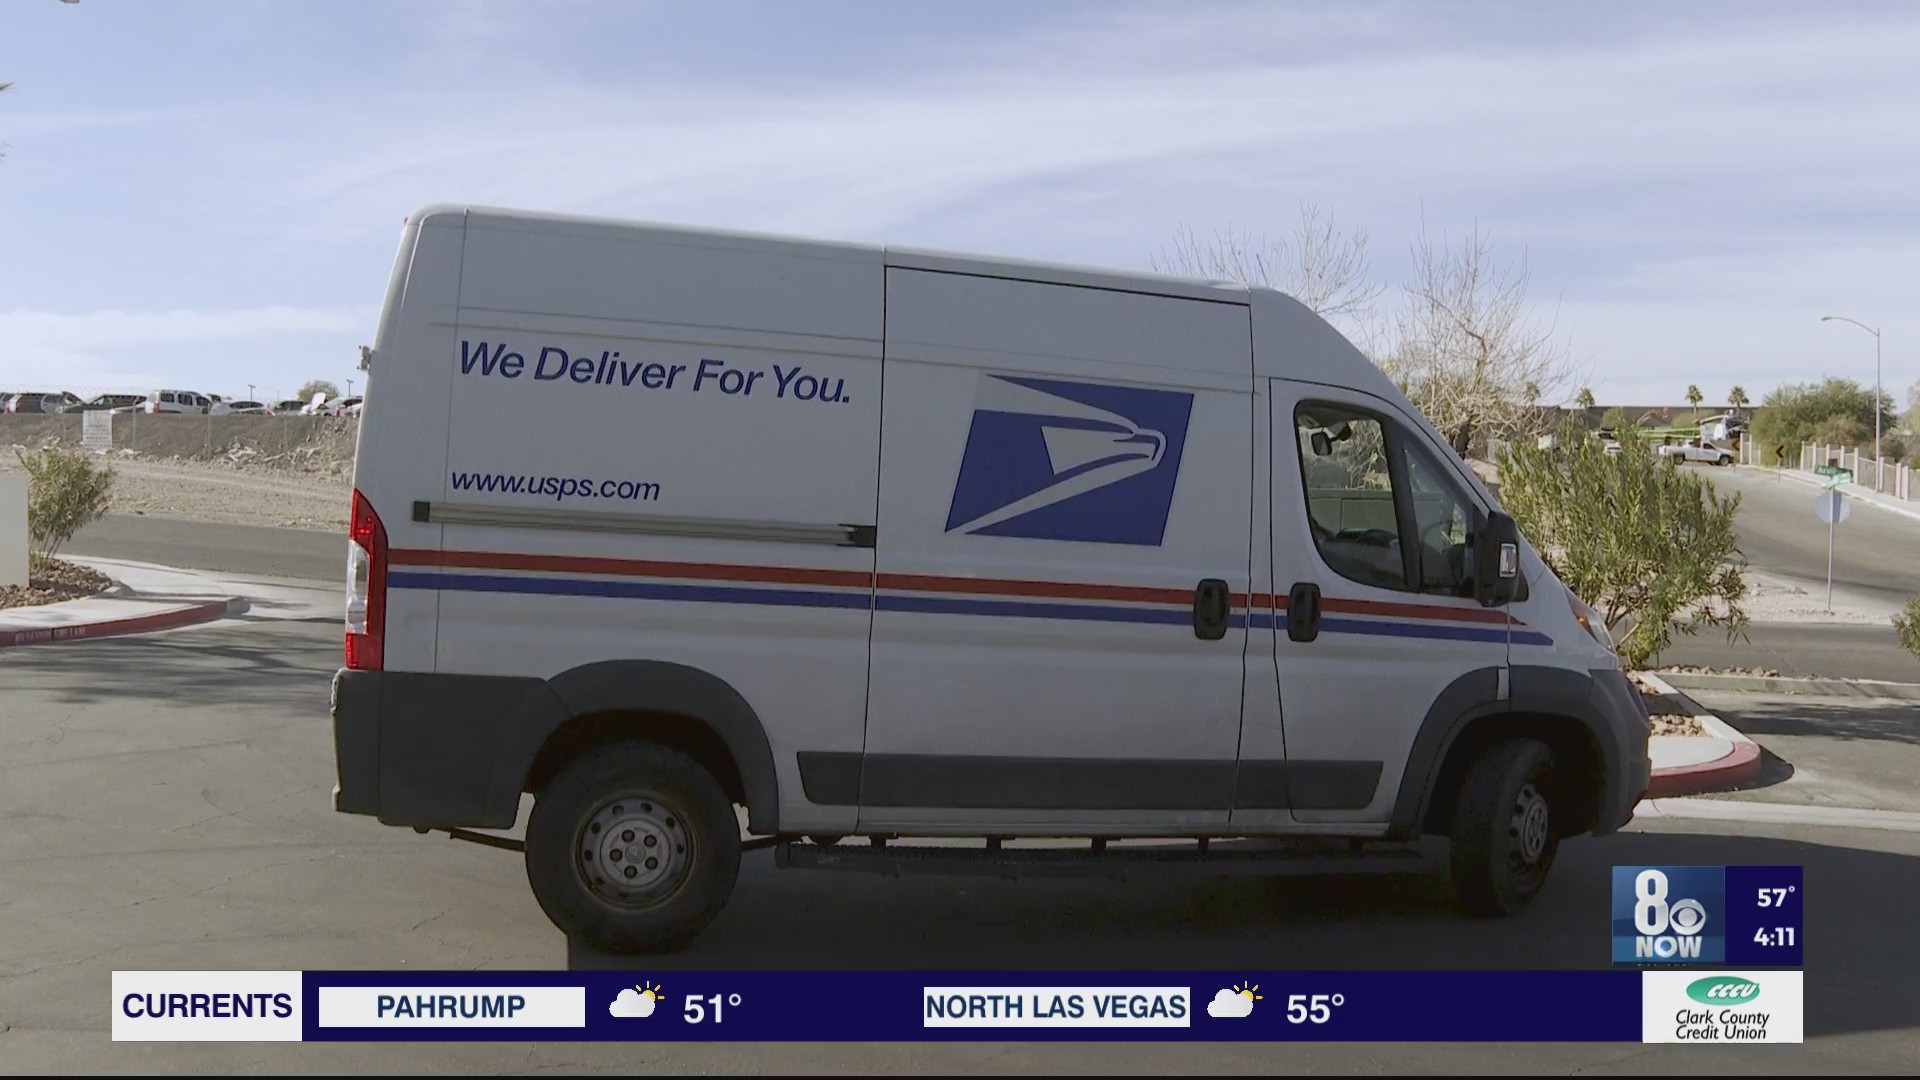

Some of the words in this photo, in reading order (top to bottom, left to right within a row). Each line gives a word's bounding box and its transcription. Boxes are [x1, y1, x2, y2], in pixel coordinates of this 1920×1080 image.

[460, 340, 525, 379] We
[533, 346, 686, 390] Deliver
[693, 358, 764, 396] For
[772, 364, 851, 404] You.
[451, 471, 661, 502] www.usps.com
